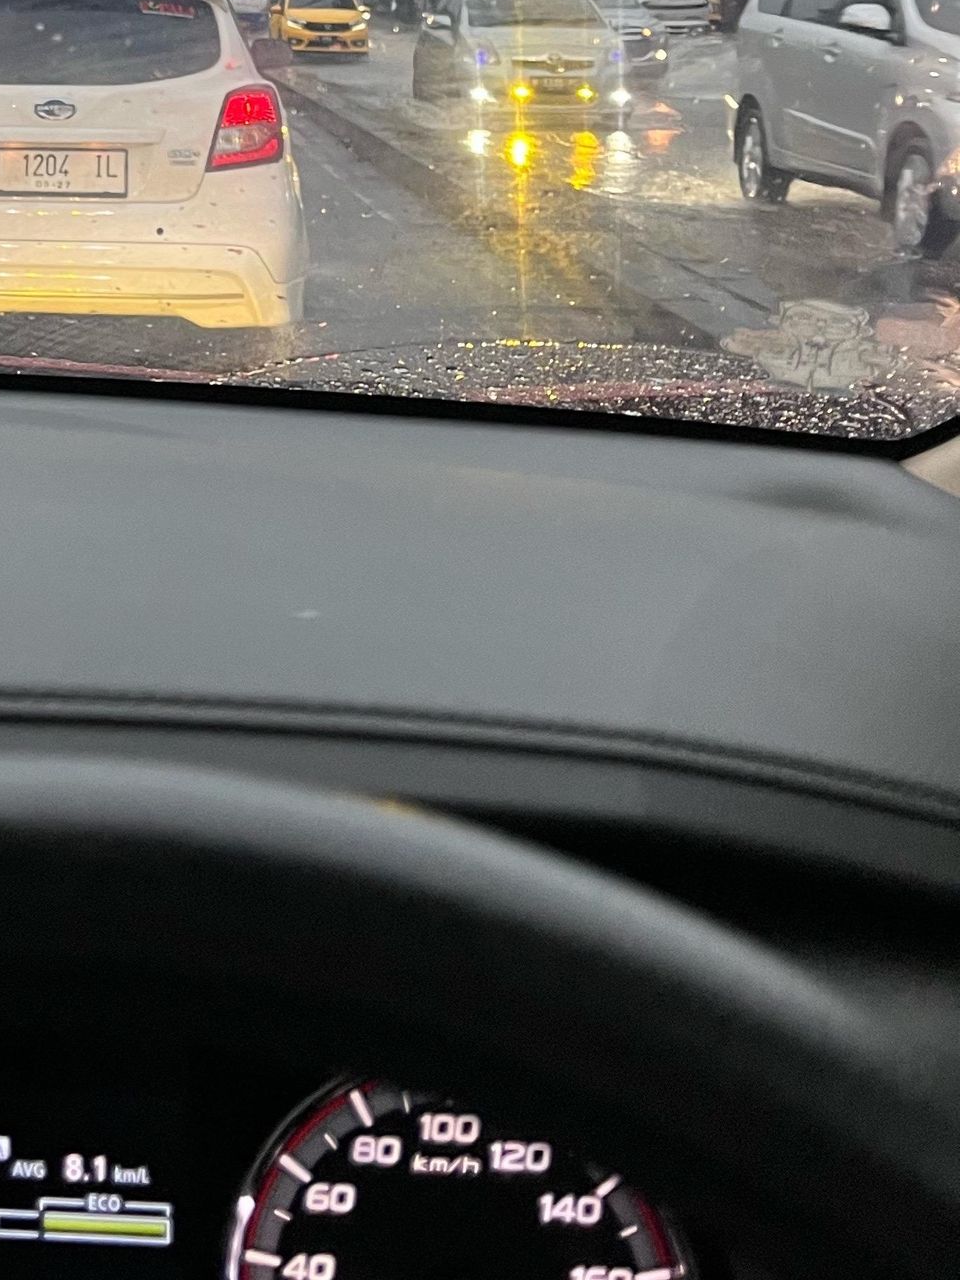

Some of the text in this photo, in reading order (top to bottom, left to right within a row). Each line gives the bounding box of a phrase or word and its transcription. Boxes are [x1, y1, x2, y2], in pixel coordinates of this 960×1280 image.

[23, 153, 69, 177] 1204
[95, 154, 119, 178] IL
[419, 1113, 481, 1144] 100
[351, 1135, 402, 1166] 80
[411, 1154, 481, 1175] km/h
[490, 1141, 552, 1172] 120
[11, 1154, 151, 1184] AVG 8.1 km/L
[87, 1193, 123, 1212] ECO
[304, 1183, 357, 1213] 60
[539, 1193, 603, 1226] 140
[281, 1253, 337, 1280] 40
